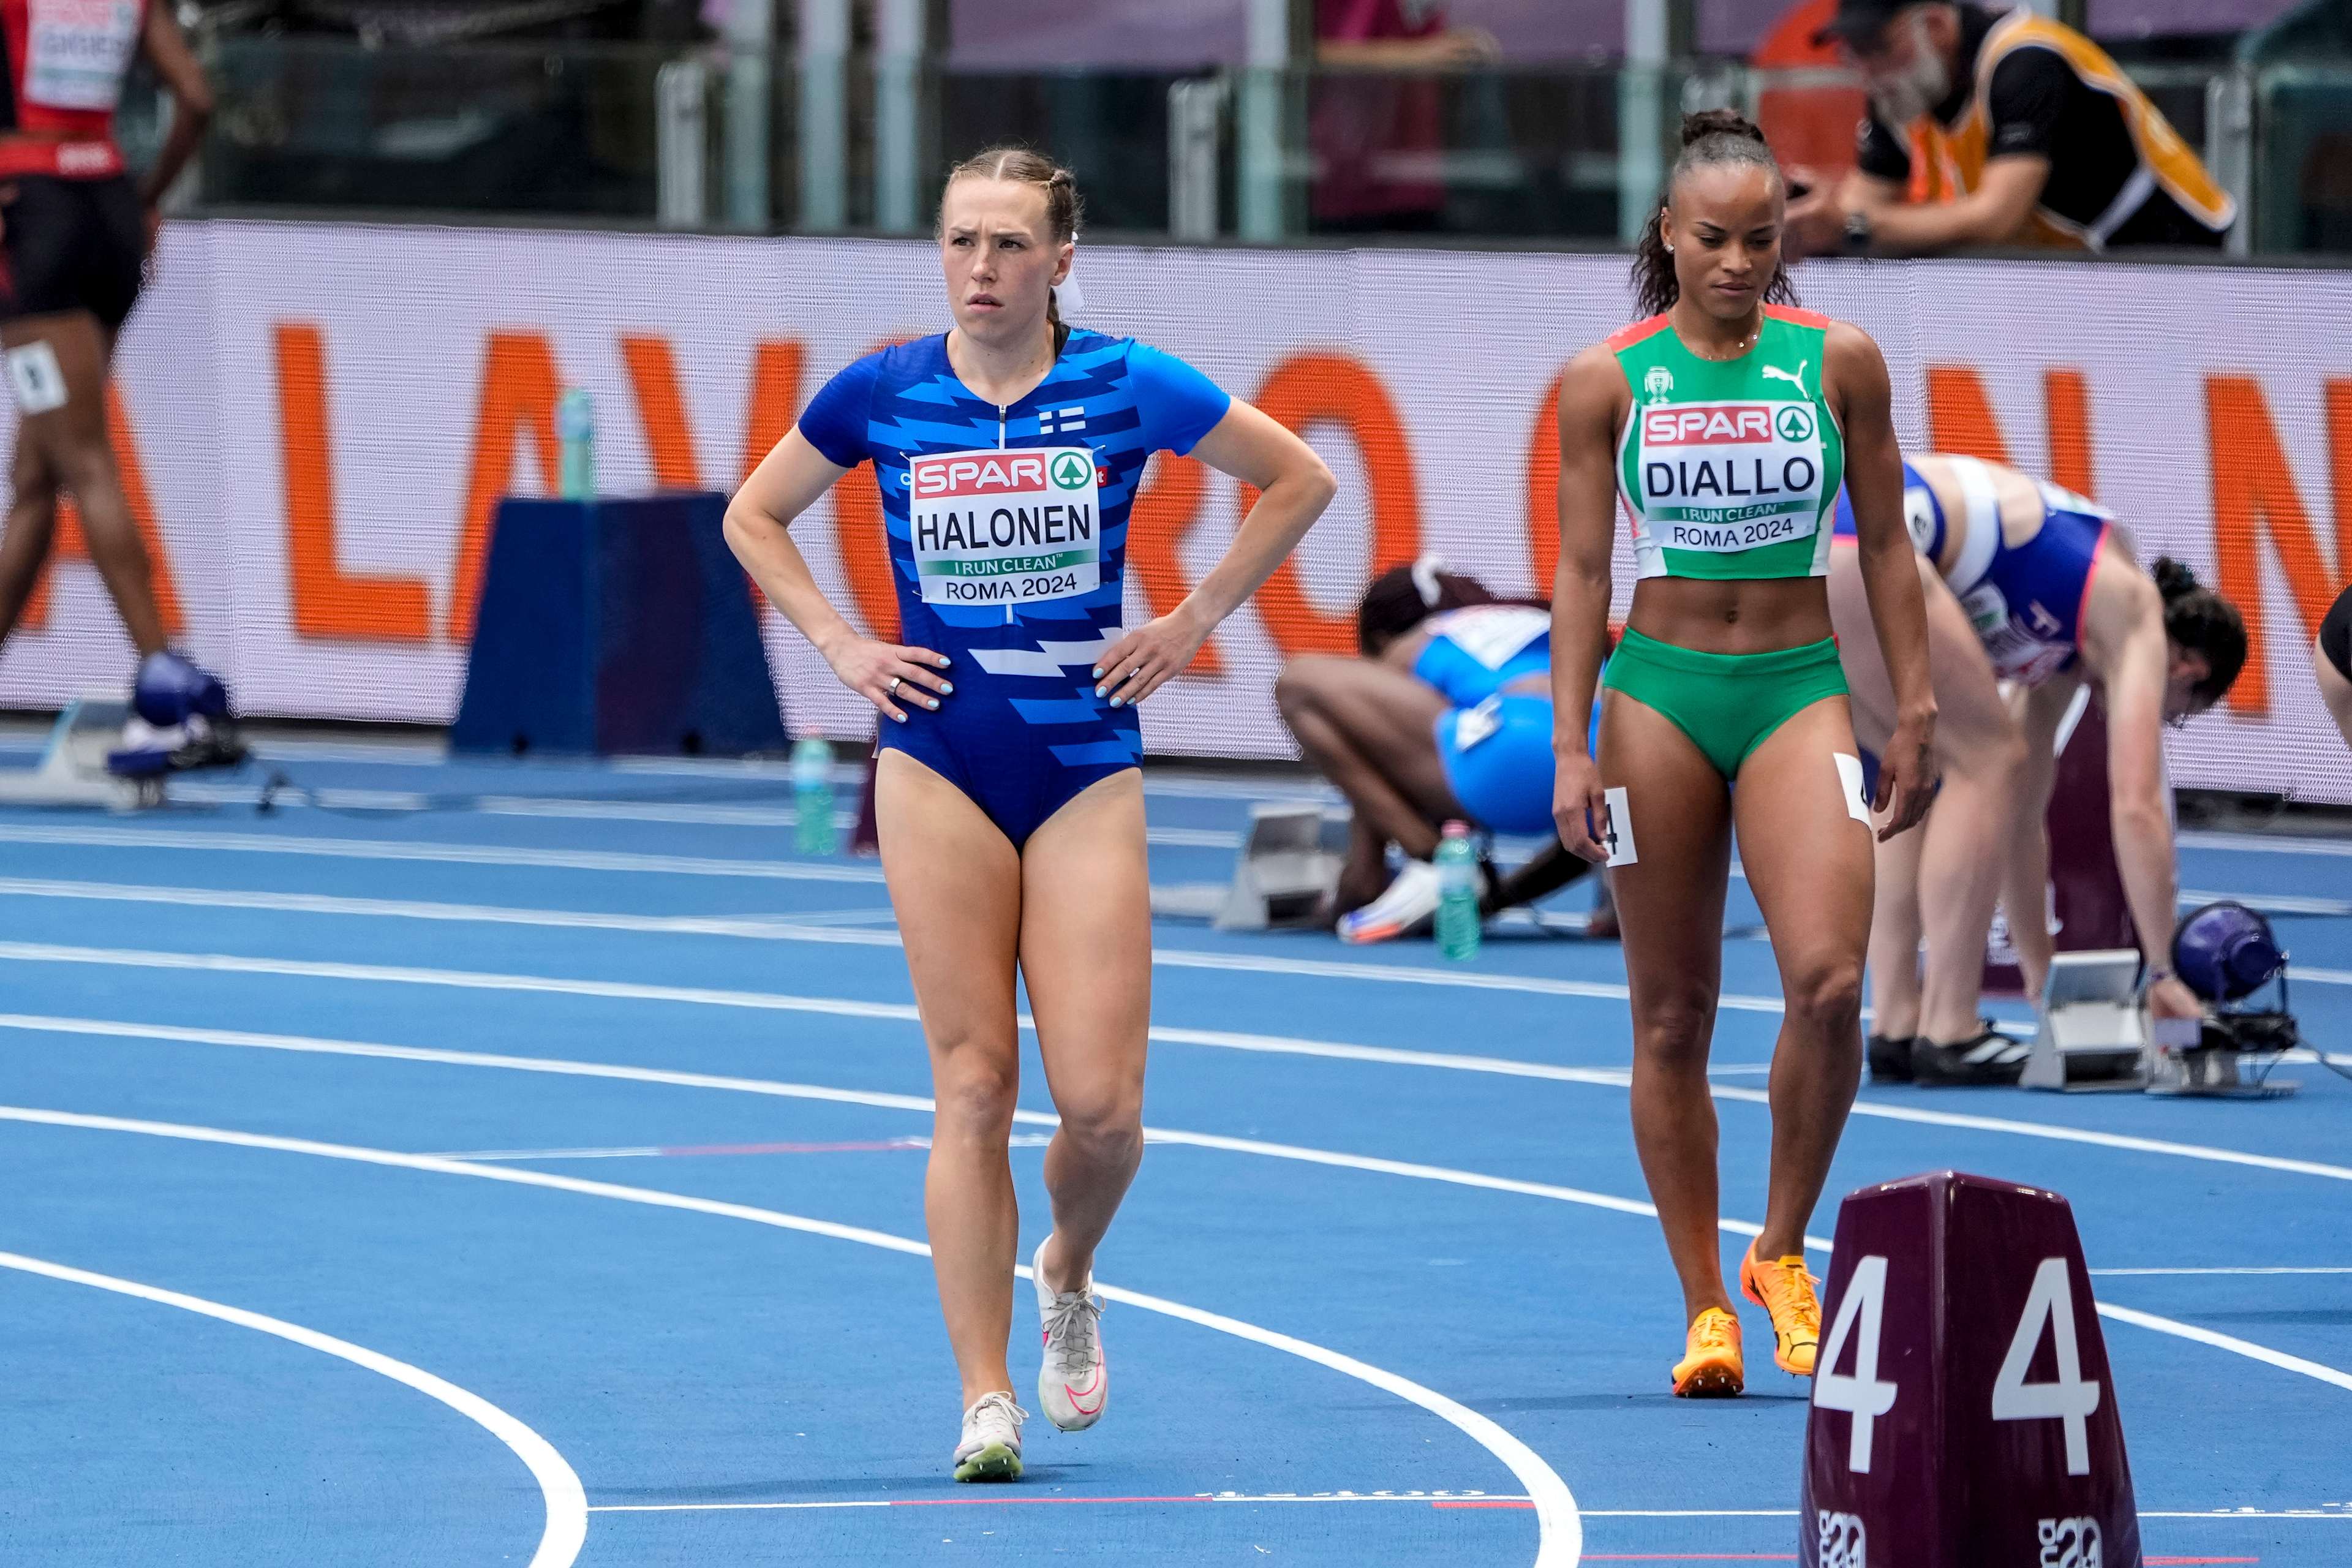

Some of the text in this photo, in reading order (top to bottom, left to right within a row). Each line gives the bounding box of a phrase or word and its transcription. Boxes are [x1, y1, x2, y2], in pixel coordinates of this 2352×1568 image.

[1648, 411, 1770, 442] SPAR
[918, 459, 1043, 494] SPAR
[1646, 457, 1815, 497] DIALLO
[918, 504, 1090, 551] HALONEN
[1690, 508, 1723, 522] RUN
[1674, 518, 1793, 547] ROMA 2024
[955, 562, 960, 575] I
[962, 560, 998, 575] RUN
[946, 573, 1077, 600] ROMA 2024
[1814, 1255, 1898, 1474] 4
[1992, 1257, 2100, 1476] 4
